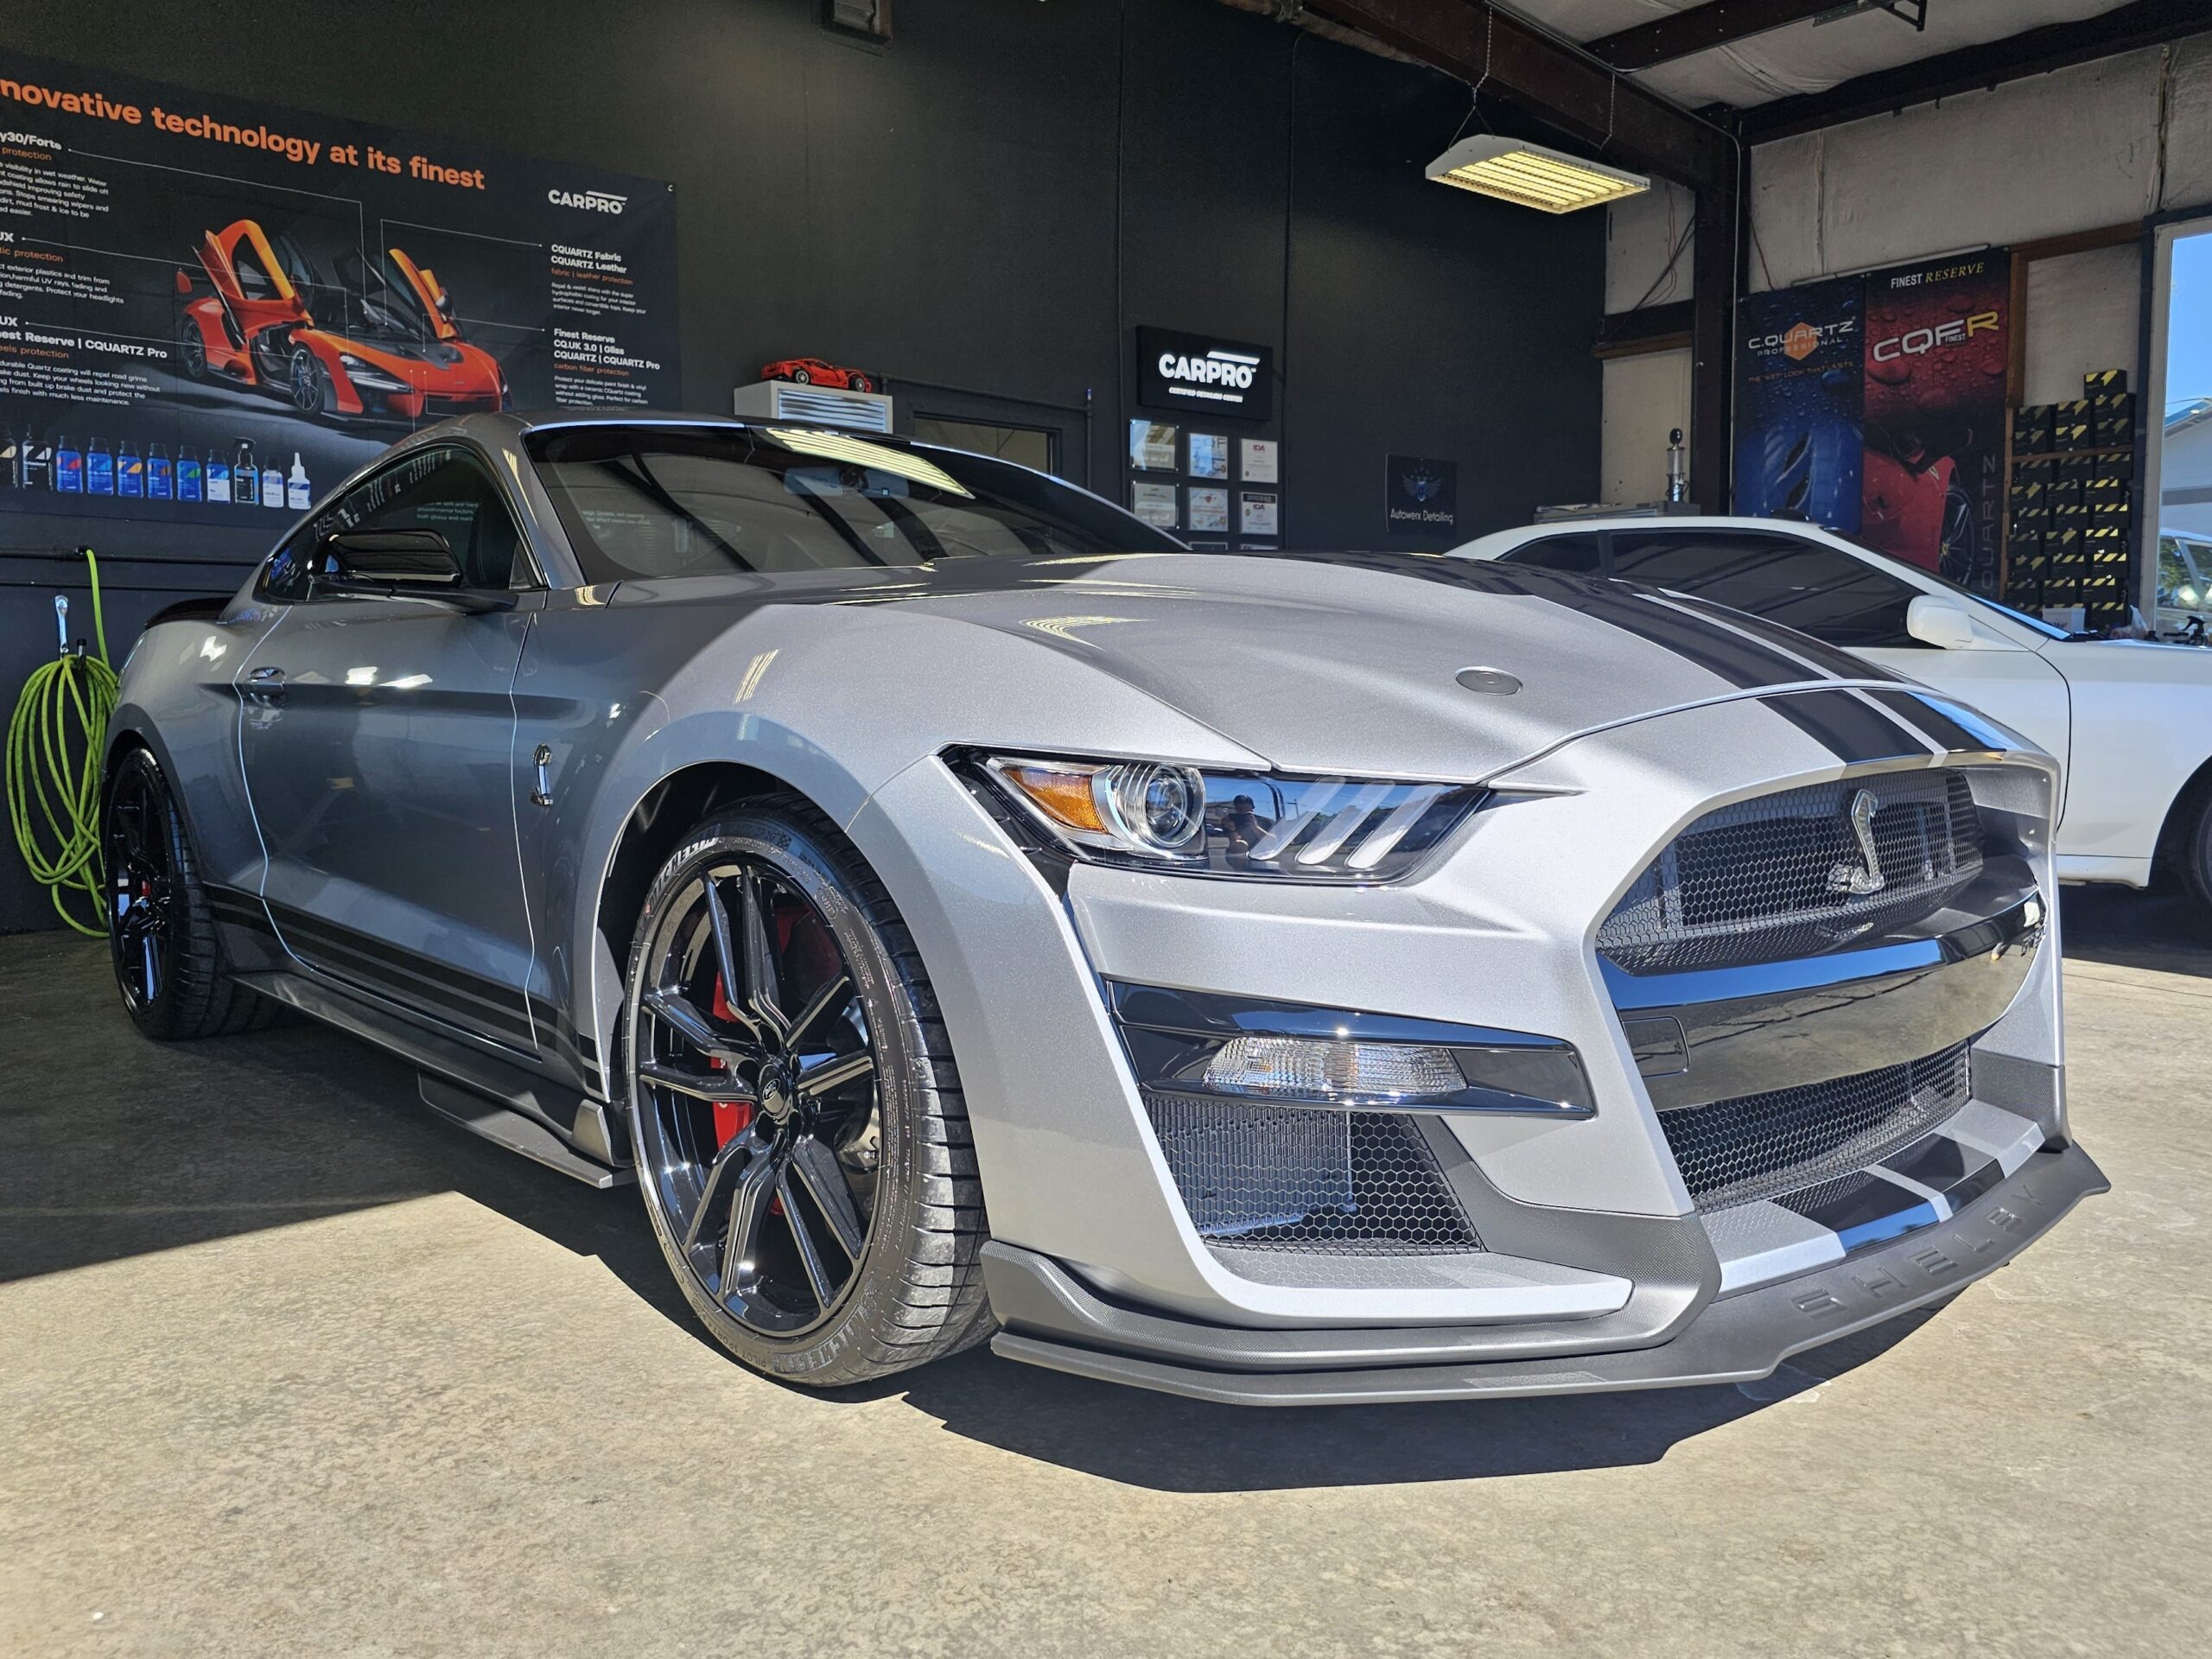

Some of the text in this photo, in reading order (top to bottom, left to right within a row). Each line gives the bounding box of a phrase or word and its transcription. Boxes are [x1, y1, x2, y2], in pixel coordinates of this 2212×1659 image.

[2, 147, 52, 161] protection
[150, 106, 321, 165] technology
[329, 143, 359, 166] at
[366, 145, 403, 175] its
[409, 155, 486, 190] finest
[4, 162, 33, 175] visibility
[87, 177, 107, 187] Water
[7, 171, 33, 183] coating
[35, 177, 57, 187] allows
[82, 185, 99, 194] slide
[16, 190, 36, 200] Stops
[37, 195, 70, 207] smearing
[70, 200, 94, 211] wipers
[95, 204, 109, 213] and
[27, 185, 62, 198] improving
[63, 191, 86, 200] safety
[548, 189, 623, 214] CARPRO
[10, 208, 34, 217] easier.
[34, 202, 50, 212] frost
[59, 207, 70, 215] ice
[79, 210, 90, 219] be
[14, 249, 64, 263] protection
[550, 244, 622, 263] CQUARTZ Fabric
[550, 255, 627, 274] CQUARTZ Leather
[7, 264, 35, 274] exterior
[35, 268, 63, 278] plastics
[93, 276, 111, 286] from
[550, 267, 634, 286] fabric leather protection
[1891, 262, 1985, 289] FINEST RESERVE
[4, 282, 44, 293] detergents.
[46, 286, 73, 297] Protect
[89, 293, 124, 304] headlights
[72, 282, 93, 293] fading
[94, 285, 108, 294] and
[0, 330, 168, 359] est Reserve CQUARTZ Pro
[554, 327, 615, 344] Finest Reserve
[1748, 321, 1853, 349] C.QUARTZ
[1873, 311, 1999, 362] CQFR
[1945, 333, 1966, 343] FINEST
[20, 347, 69, 359] protection
[583, 343, 598, 353] 3.0
[604, 346, 625, 355] Gliss
[553, 362, 630, 377] carbon fiber protection
[554, 350, 661, 371] CQUARTZ CQUARTZ Pro
[0, 359, 26, 369] durable
[27, 362, 52, 372] Quartz
[53, 366, 79, 376] coating
[128, 375, 148, 384] grime
[1159, 353, 1253, 389] CARPRO
[9, 378, 27, 386] from
[55, 383, 76, 391] brake
[108, 389, 133, 398] protect
[33, 372, 52, 381] Keep
[69, 377, 94, 385] wheels
[95, 379, 119, 389] looking
[136, 385, 161, 393] without
[86, 396, 130, 406] maintenance.
[1389, 507, 1453, 525] Autowerx Detailing
[1791, 1184, 2048, 1320] SHELBY
[712, 1326, 766, 1368] PILOT SPORT
